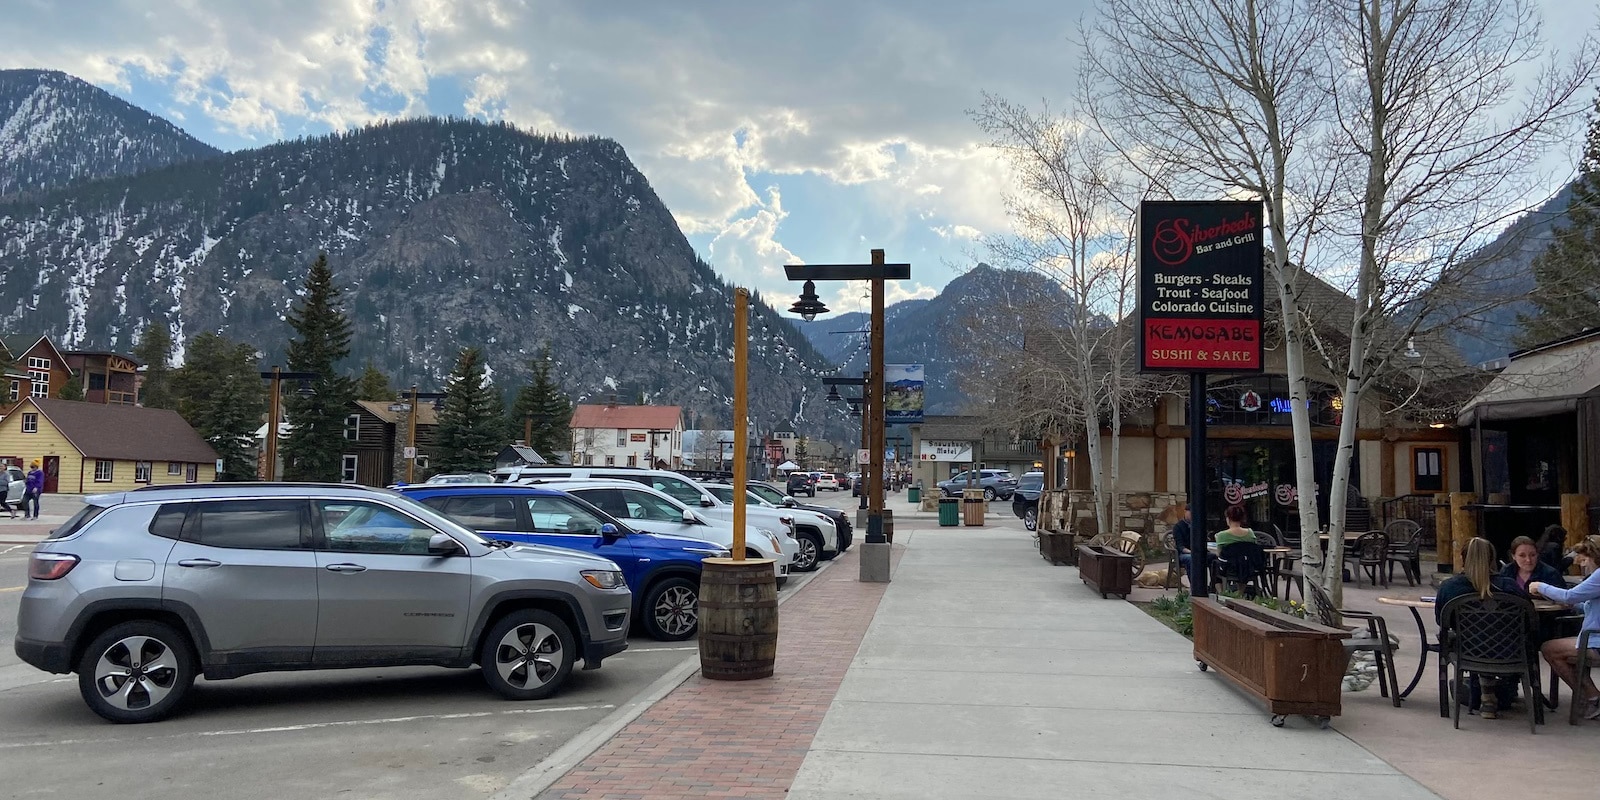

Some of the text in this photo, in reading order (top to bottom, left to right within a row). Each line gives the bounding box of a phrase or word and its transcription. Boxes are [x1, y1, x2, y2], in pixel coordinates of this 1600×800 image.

[1152, 211, 1255, 265] Silverheels
[1195, 232, 1255, 255] Bar and Grill
[1154, 273, 1202, 287] Burgers
[1212, 273, 1252, 285] Steaks
[1157, 287, 1191, 298] Trout
[1201, 287, 1249, 301] Seafood
[1152, 301, 1254, 313] Colorado Cuisine
[1149, 324, 1254, 343] KEMOSABE
[1152, 349, 1251, 361] SUSHI & SAKE
[936, 447, 957, 455] Motel
